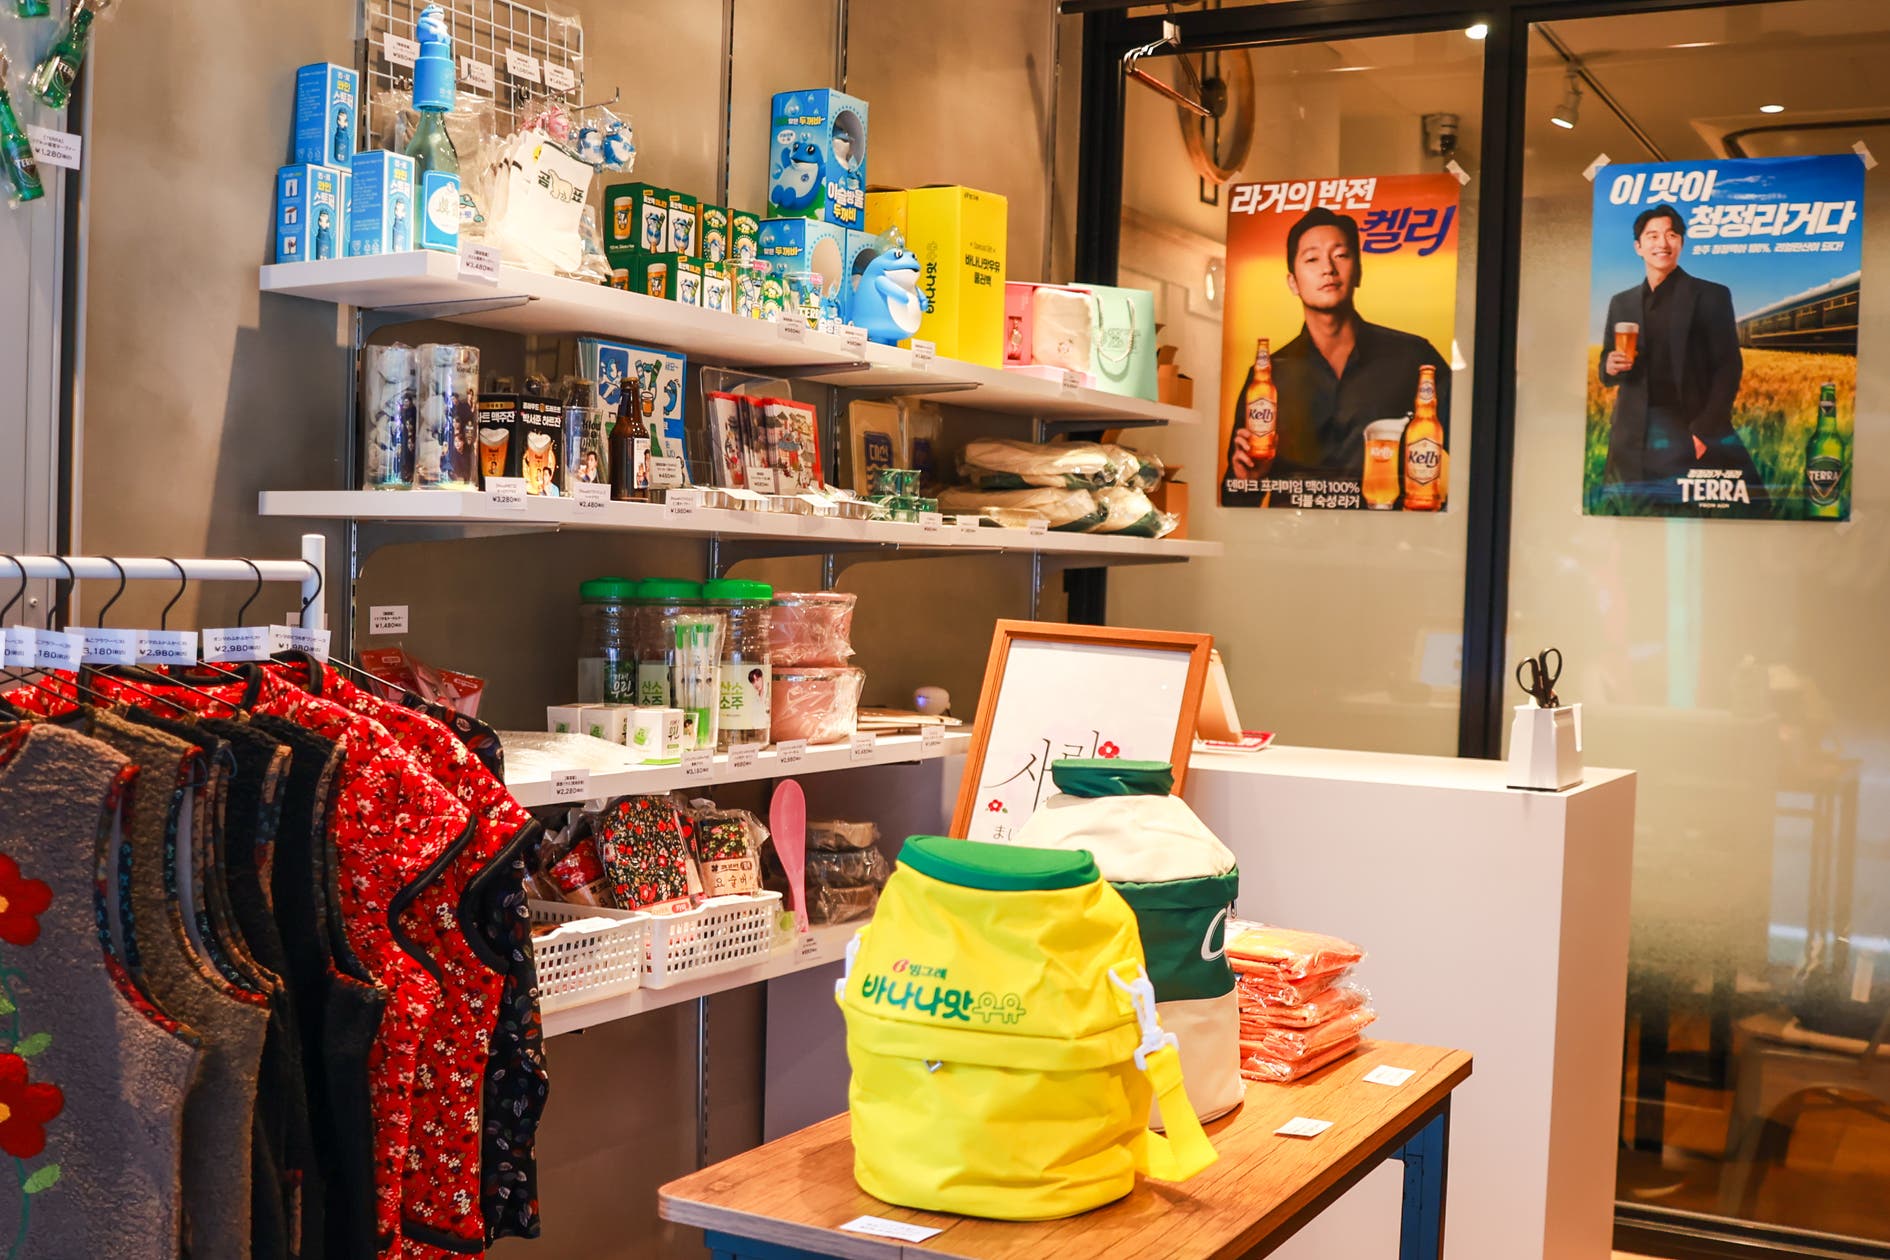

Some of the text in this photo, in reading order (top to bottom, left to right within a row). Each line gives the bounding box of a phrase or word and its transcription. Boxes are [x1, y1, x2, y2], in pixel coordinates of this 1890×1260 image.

[1609, 169, 1718, 204] 이 맛이
[828, 182, 864, 210] 이슬방울
[1230, 177, 1377, 215] 라거의 반전
[833, 203, 856, 222] 두꺼비
[1687, 200, 1856, 239] 청정라거다
[1358, 205, 1457, 256] 켈리
[1249, 409, 1273, 423] Kelly
[1408, 450, 1439, 468] Kelly
[1808, 470, 1839, 481] TERRA
[1226, 479, 1360, 494] 덴마크 프리미엄 맥아 100%
[1676, 478, 1751, 505] TERRA
[611, 681, 633, 699] 우린
[642, 681, 663, 694] 산소
[720, 681, 743, 695] 산소
[720, 696, 743, 710] 소주
[909, 963, 948, 981] 빙그레
[862, 973, 1026, 1025] 바나나맛우유
